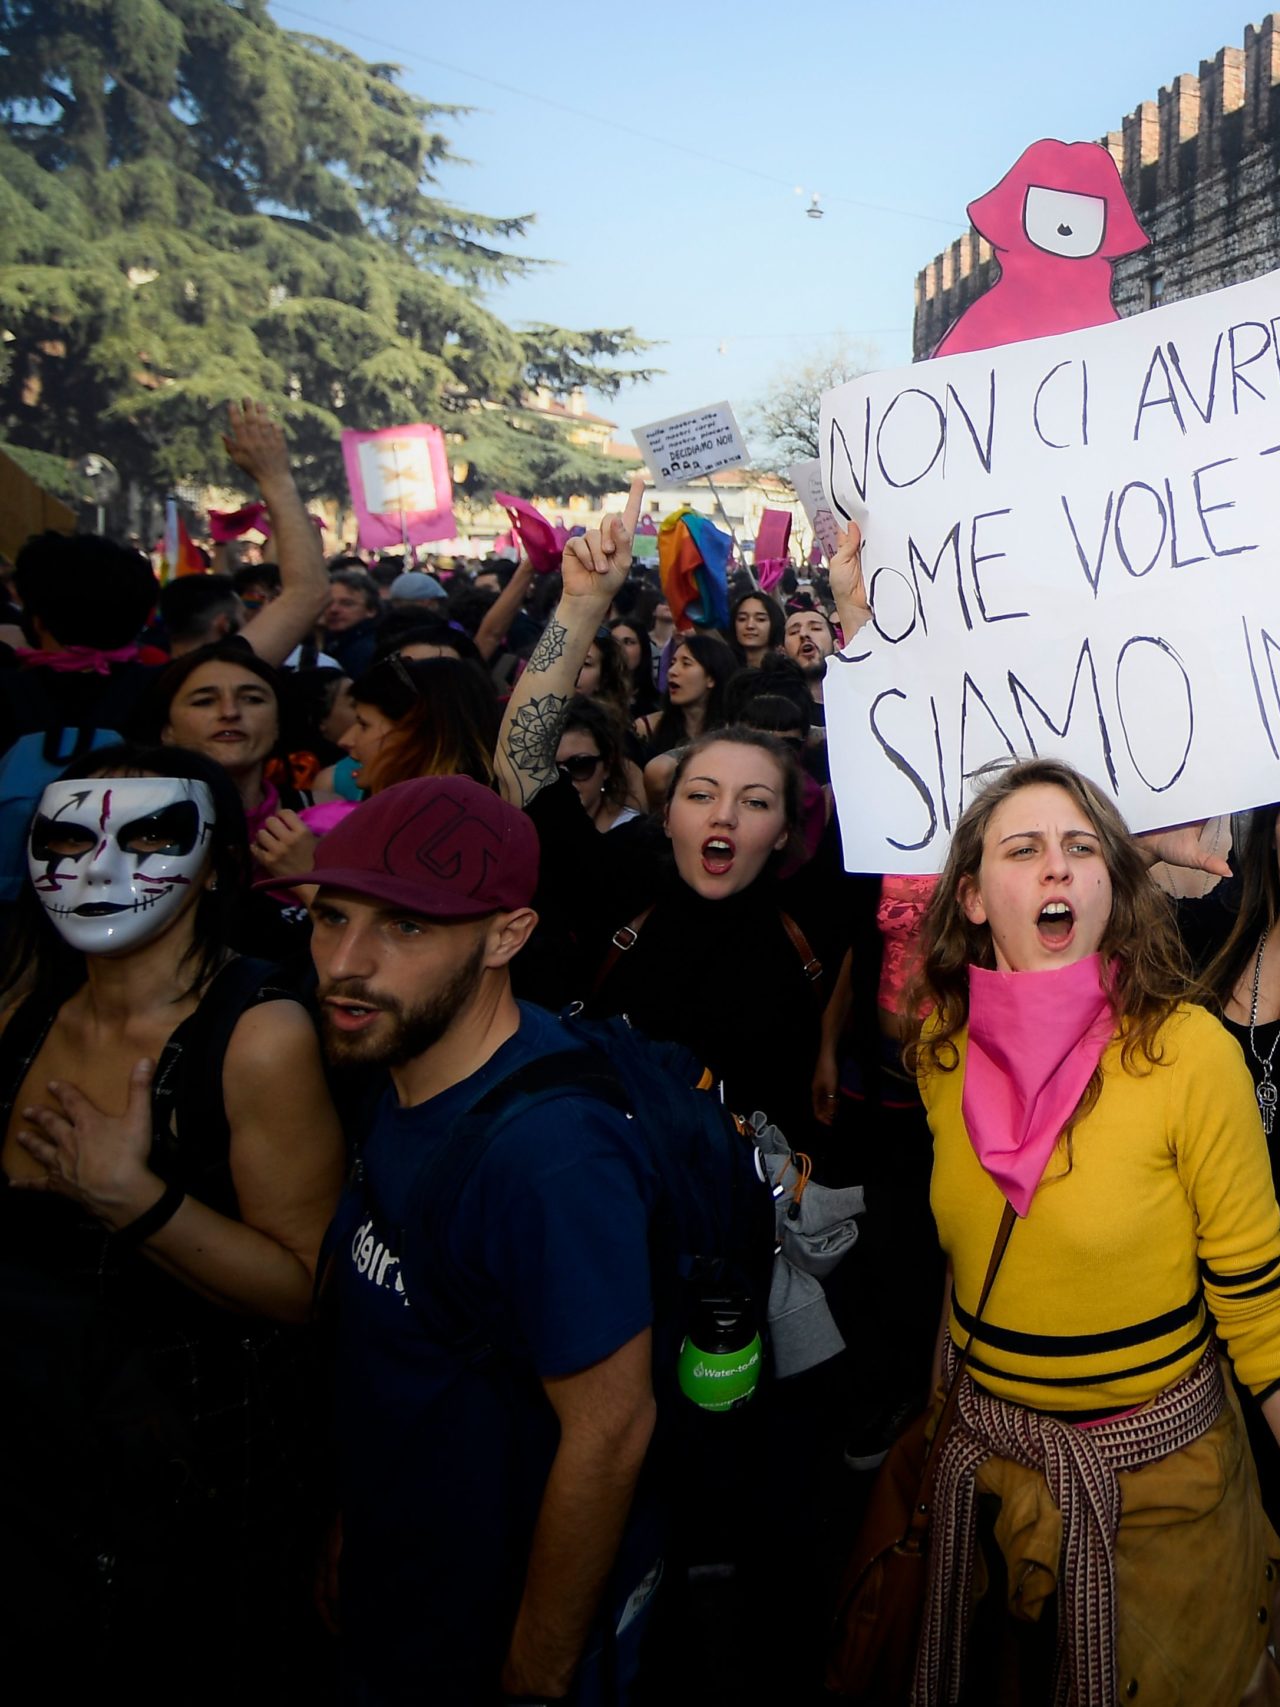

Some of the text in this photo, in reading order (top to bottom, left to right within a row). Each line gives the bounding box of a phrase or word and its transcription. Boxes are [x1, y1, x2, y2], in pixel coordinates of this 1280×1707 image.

[829, 369, 995, 520] NON
[1032, 359, 1089, 449] CI
[869, 637, 1194, 851] SIAMO
